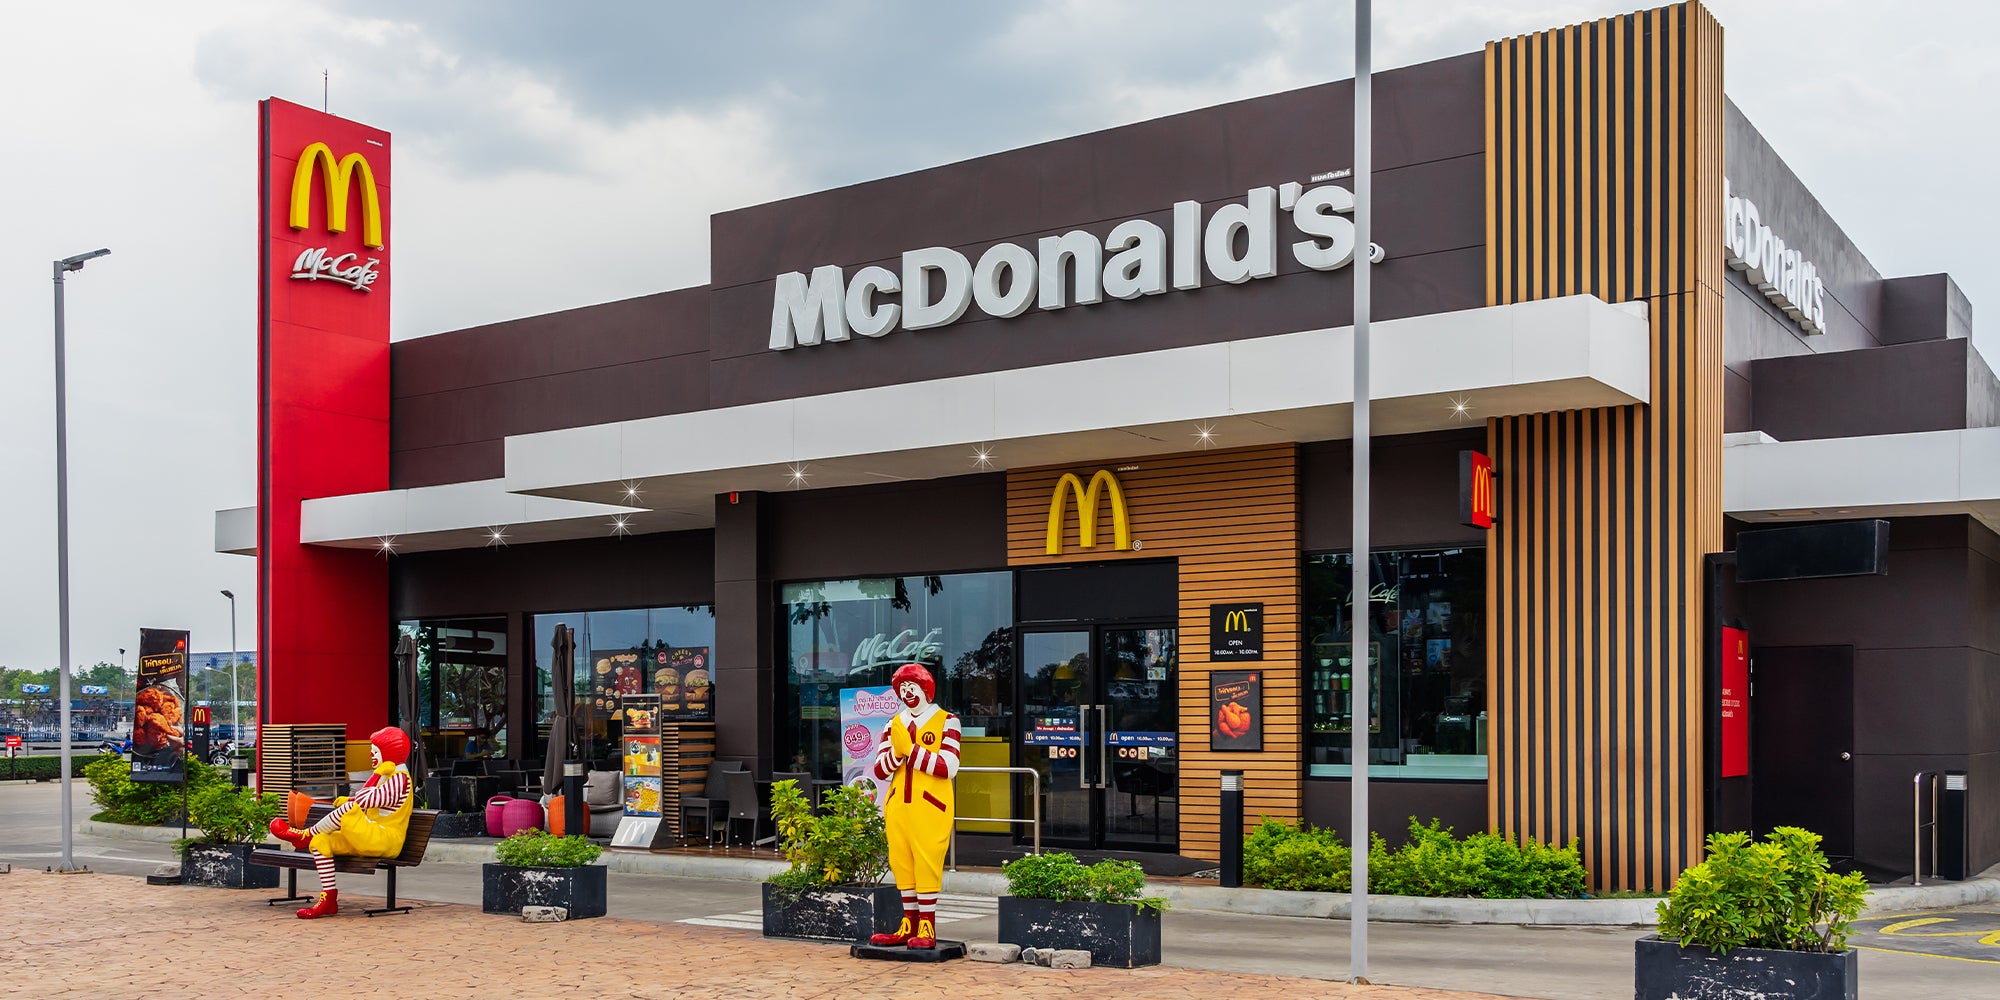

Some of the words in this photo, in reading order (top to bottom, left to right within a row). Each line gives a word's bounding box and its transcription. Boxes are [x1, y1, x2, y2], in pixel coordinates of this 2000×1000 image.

[290, 246, 380, 293] McCafé
[769, 181, 1357, 352] McDonald's
[1724, 177, 1824, 335] cDonald's
[850, 627, 944, 675] McCafé
[853, 702, 866, 712] MY
[867, 701, 901, 710] MELODY
